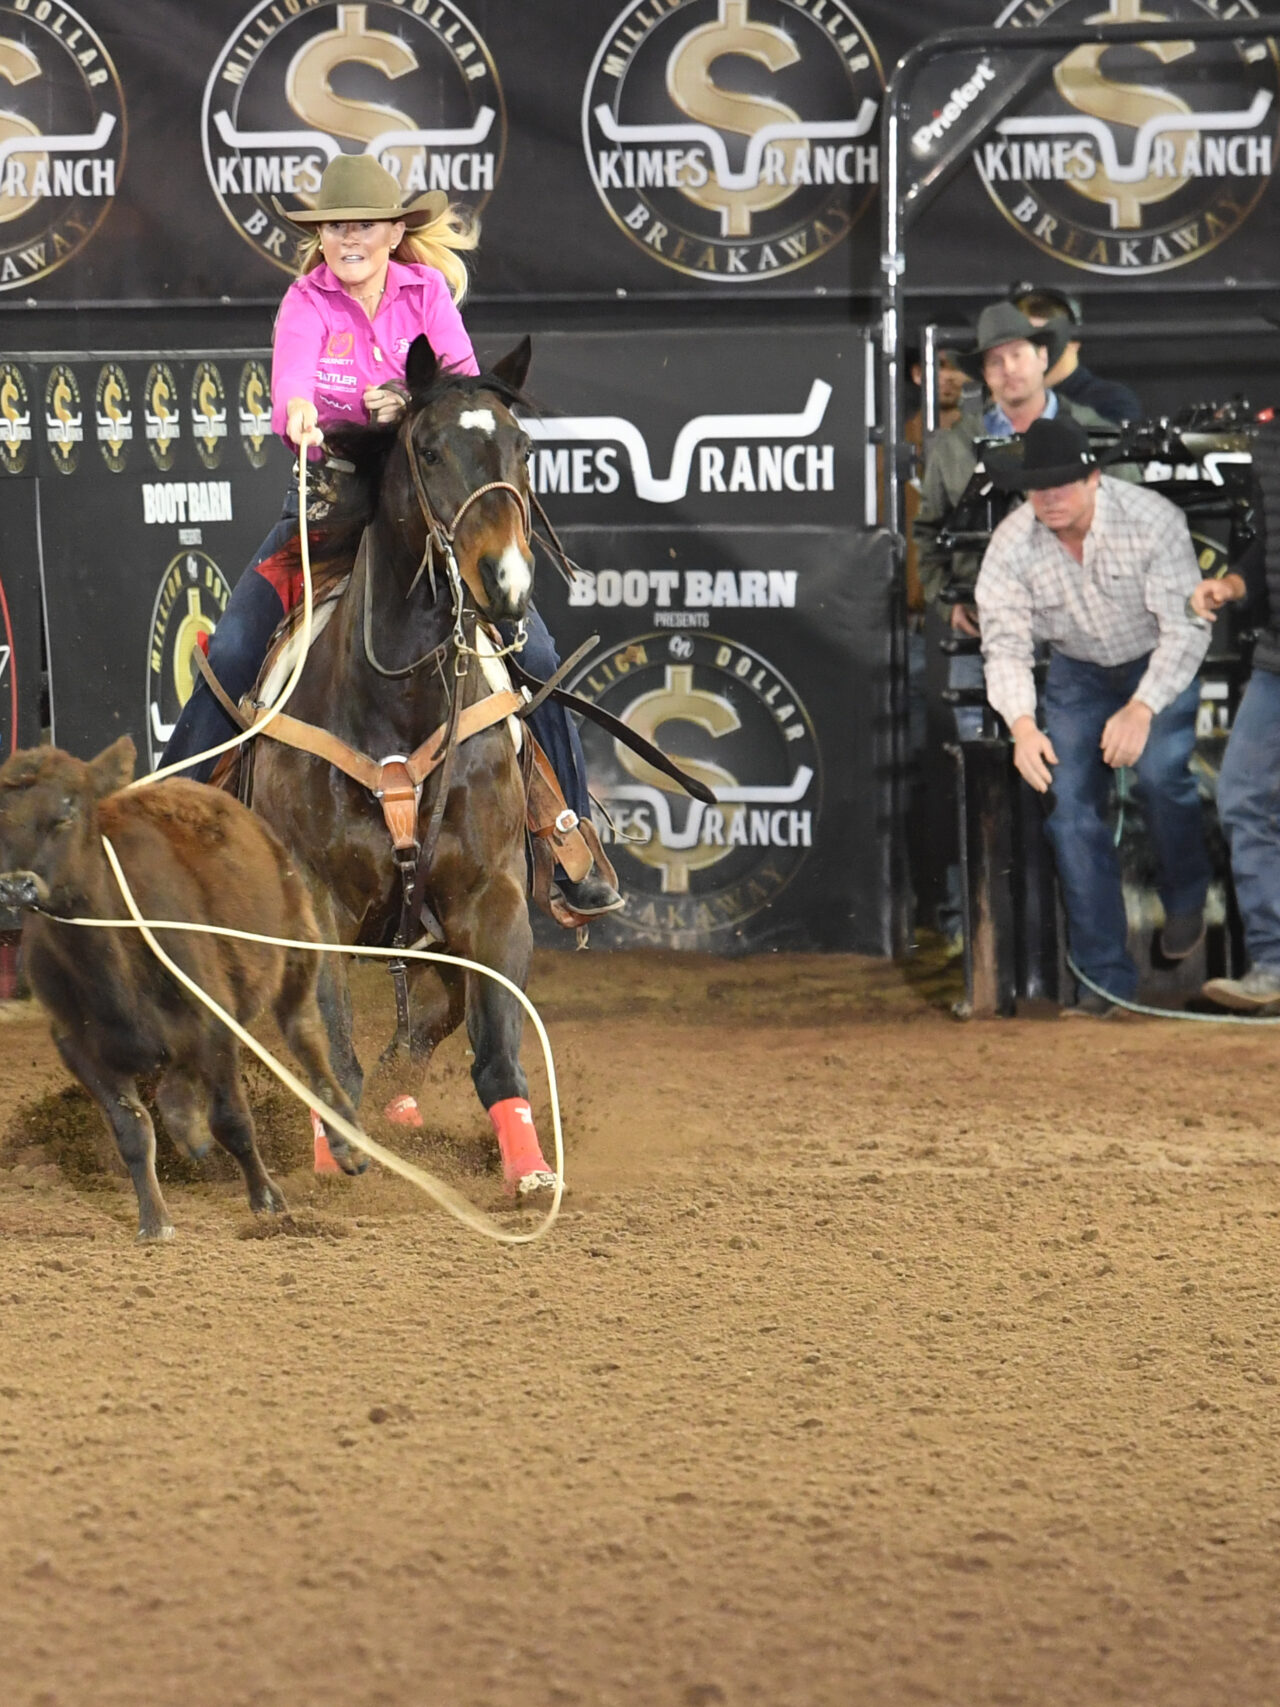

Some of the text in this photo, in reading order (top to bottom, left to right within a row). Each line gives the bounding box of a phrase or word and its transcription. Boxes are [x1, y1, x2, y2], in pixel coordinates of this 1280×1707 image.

[222, 0, 487, 85] MILLIO OLLAR
[7, 159, 116, 198] RANCH
[219, 155, 321, 195] KIMES
[599, 145, 880, 189] KIMES RANCH
[983, 135, 1273, 182] KIMES RANCH
[623, 203, 851, 274] BREAKAWAY
[526, 444, 835, 494] IMES RANCH
[142, 481, 233, 524] BOOT BARN
[568, 569, 799, 608] BOOT BARN
[653, 611, 710, 629] PRESENTS
[715, 645, 805, 742] DOLLAR
[703, 806, 813, 848] RANCH
